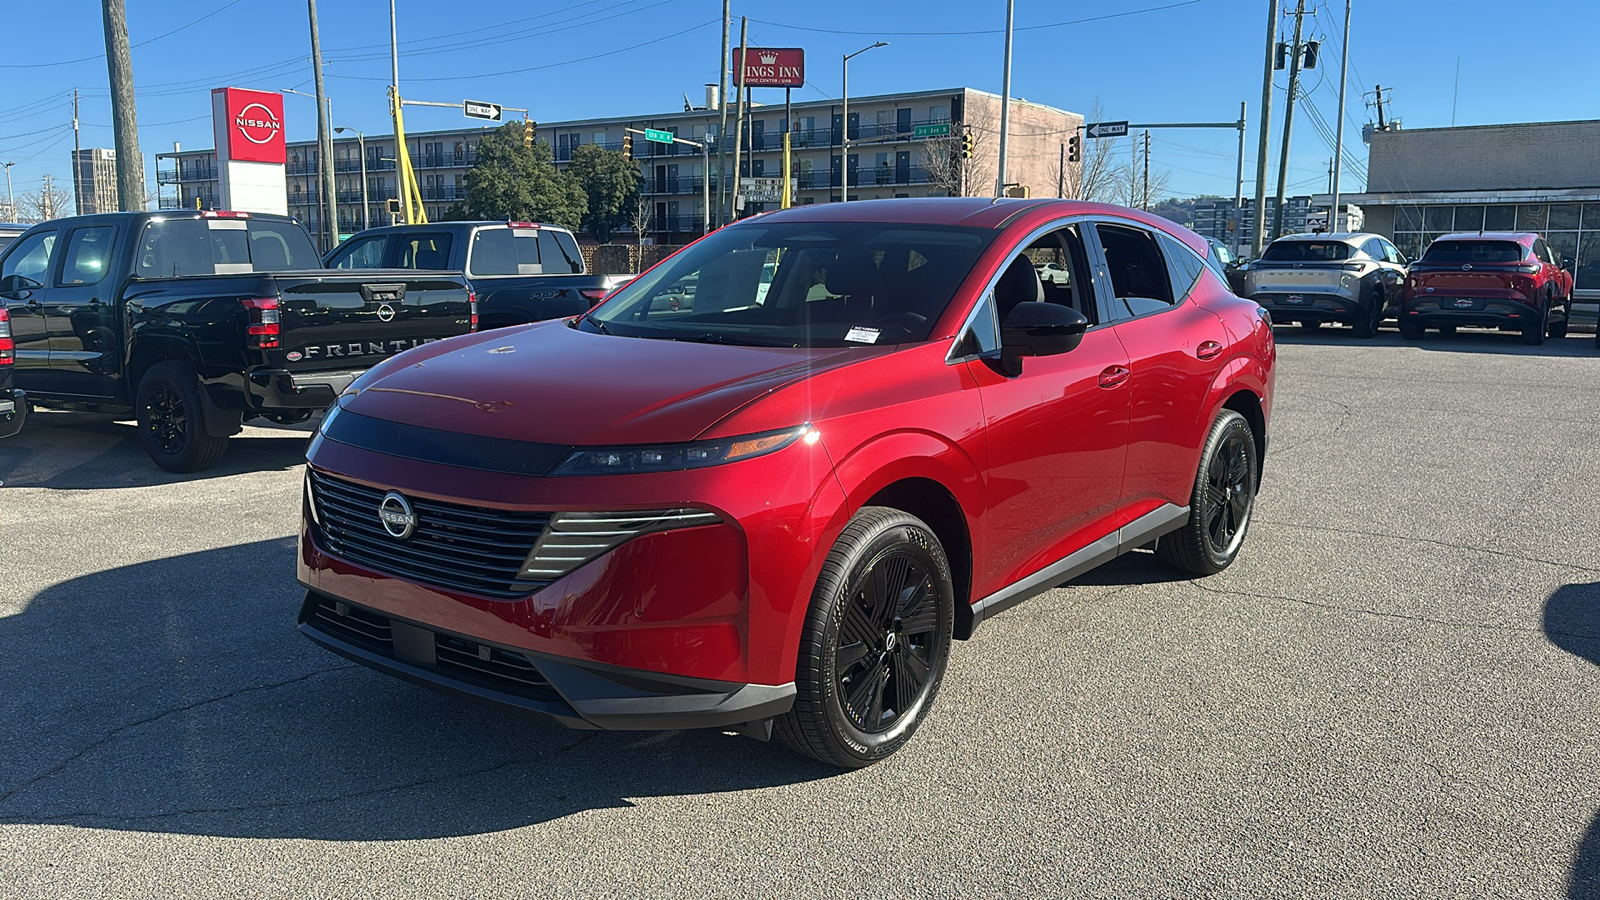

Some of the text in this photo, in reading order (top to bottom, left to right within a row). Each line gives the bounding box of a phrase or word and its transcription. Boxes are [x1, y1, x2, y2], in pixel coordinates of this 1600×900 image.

[737, 66, 800, 78] INGS INN
[469, 105, 479, 114] ONE
[236, 117, 280, 129] NISSAN
[1098, 126, 1109, 134] ONE
[379, 509, 414, 525] SSAN
